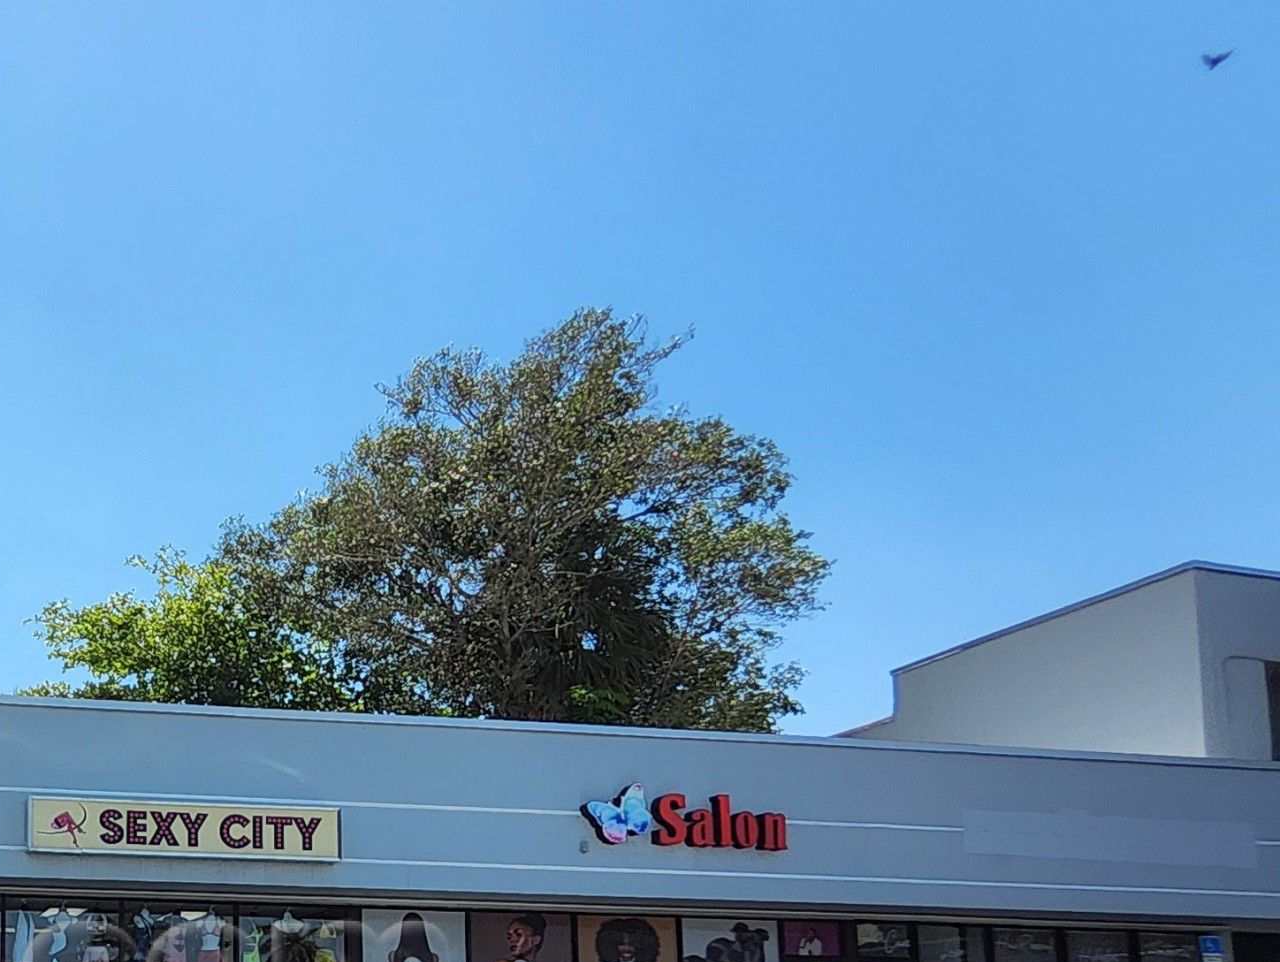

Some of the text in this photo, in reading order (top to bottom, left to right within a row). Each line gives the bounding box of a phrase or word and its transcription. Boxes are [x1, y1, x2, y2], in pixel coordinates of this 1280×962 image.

[98, 808, 322, 851] SEXY CITY
[649, 792, 788, 851] Salon
